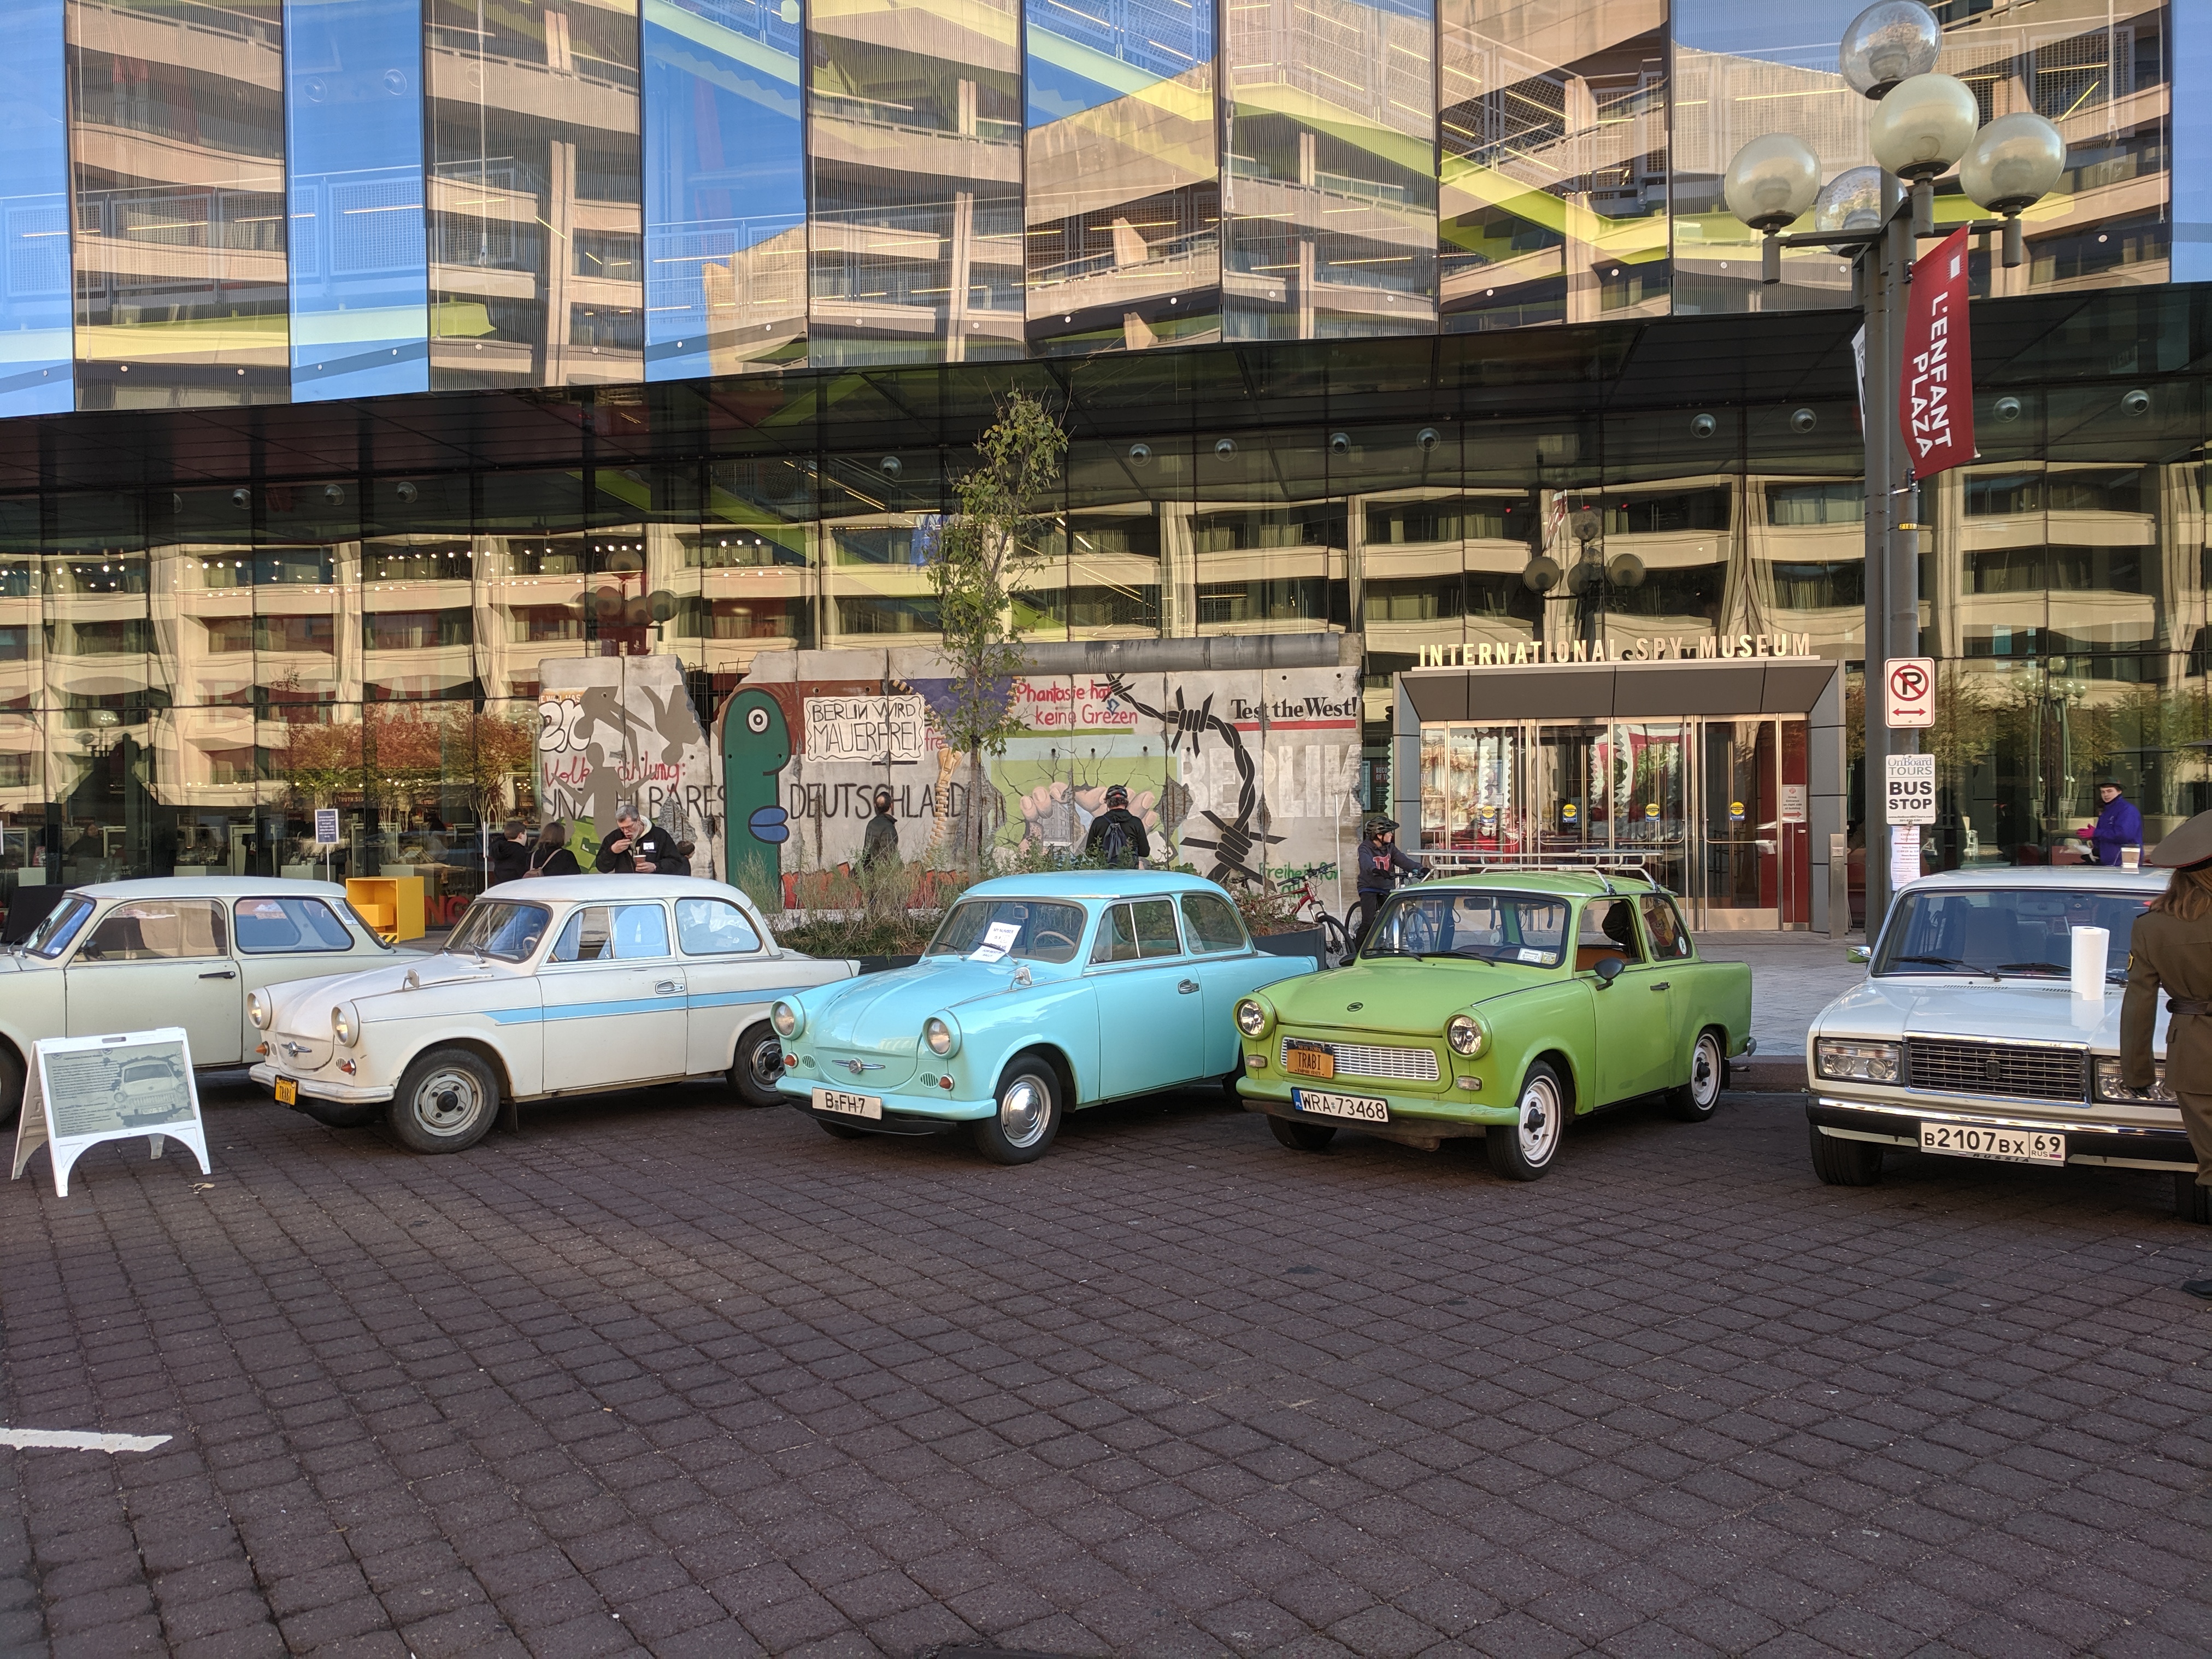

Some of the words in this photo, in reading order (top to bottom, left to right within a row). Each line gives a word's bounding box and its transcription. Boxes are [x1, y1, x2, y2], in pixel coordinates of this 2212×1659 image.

[1929, 291, 1952, 448] L'ENFANT
[1911, 351, 1933, 458] PLAZA
[1419, 639, 1621, 667] INTERNATIONAL
[1635, 636, 1683, 660] SPY
[1698, 633, 1810, 658] MUSEUM
[1016, 680, 1085, 704] Phantasie
[812, 704, 869, 723] BERLIN
[872, 702, 916, 719] WIRD
[1036, 705, 1077, 726] keine
[1231, 698, 1269, 720] Test
[1272, 698, 1304, 718] the
[1303, 696, 1358, 718] West!
[813, 721, 918, 754] MAUERFREI
[1889, 766, 1932, 775] TOURS
[1180, 744, 1363, 820] BERLIN
[1889, 781, 1932, 795] BUS
[1889, 798, 1932, 810] STOP
[1298, 1051, 1321, 1070] TRABI
[2034, 1134, 2061, 1152] 69
[1972, 1153, 2029, 1163] RUSSIA
